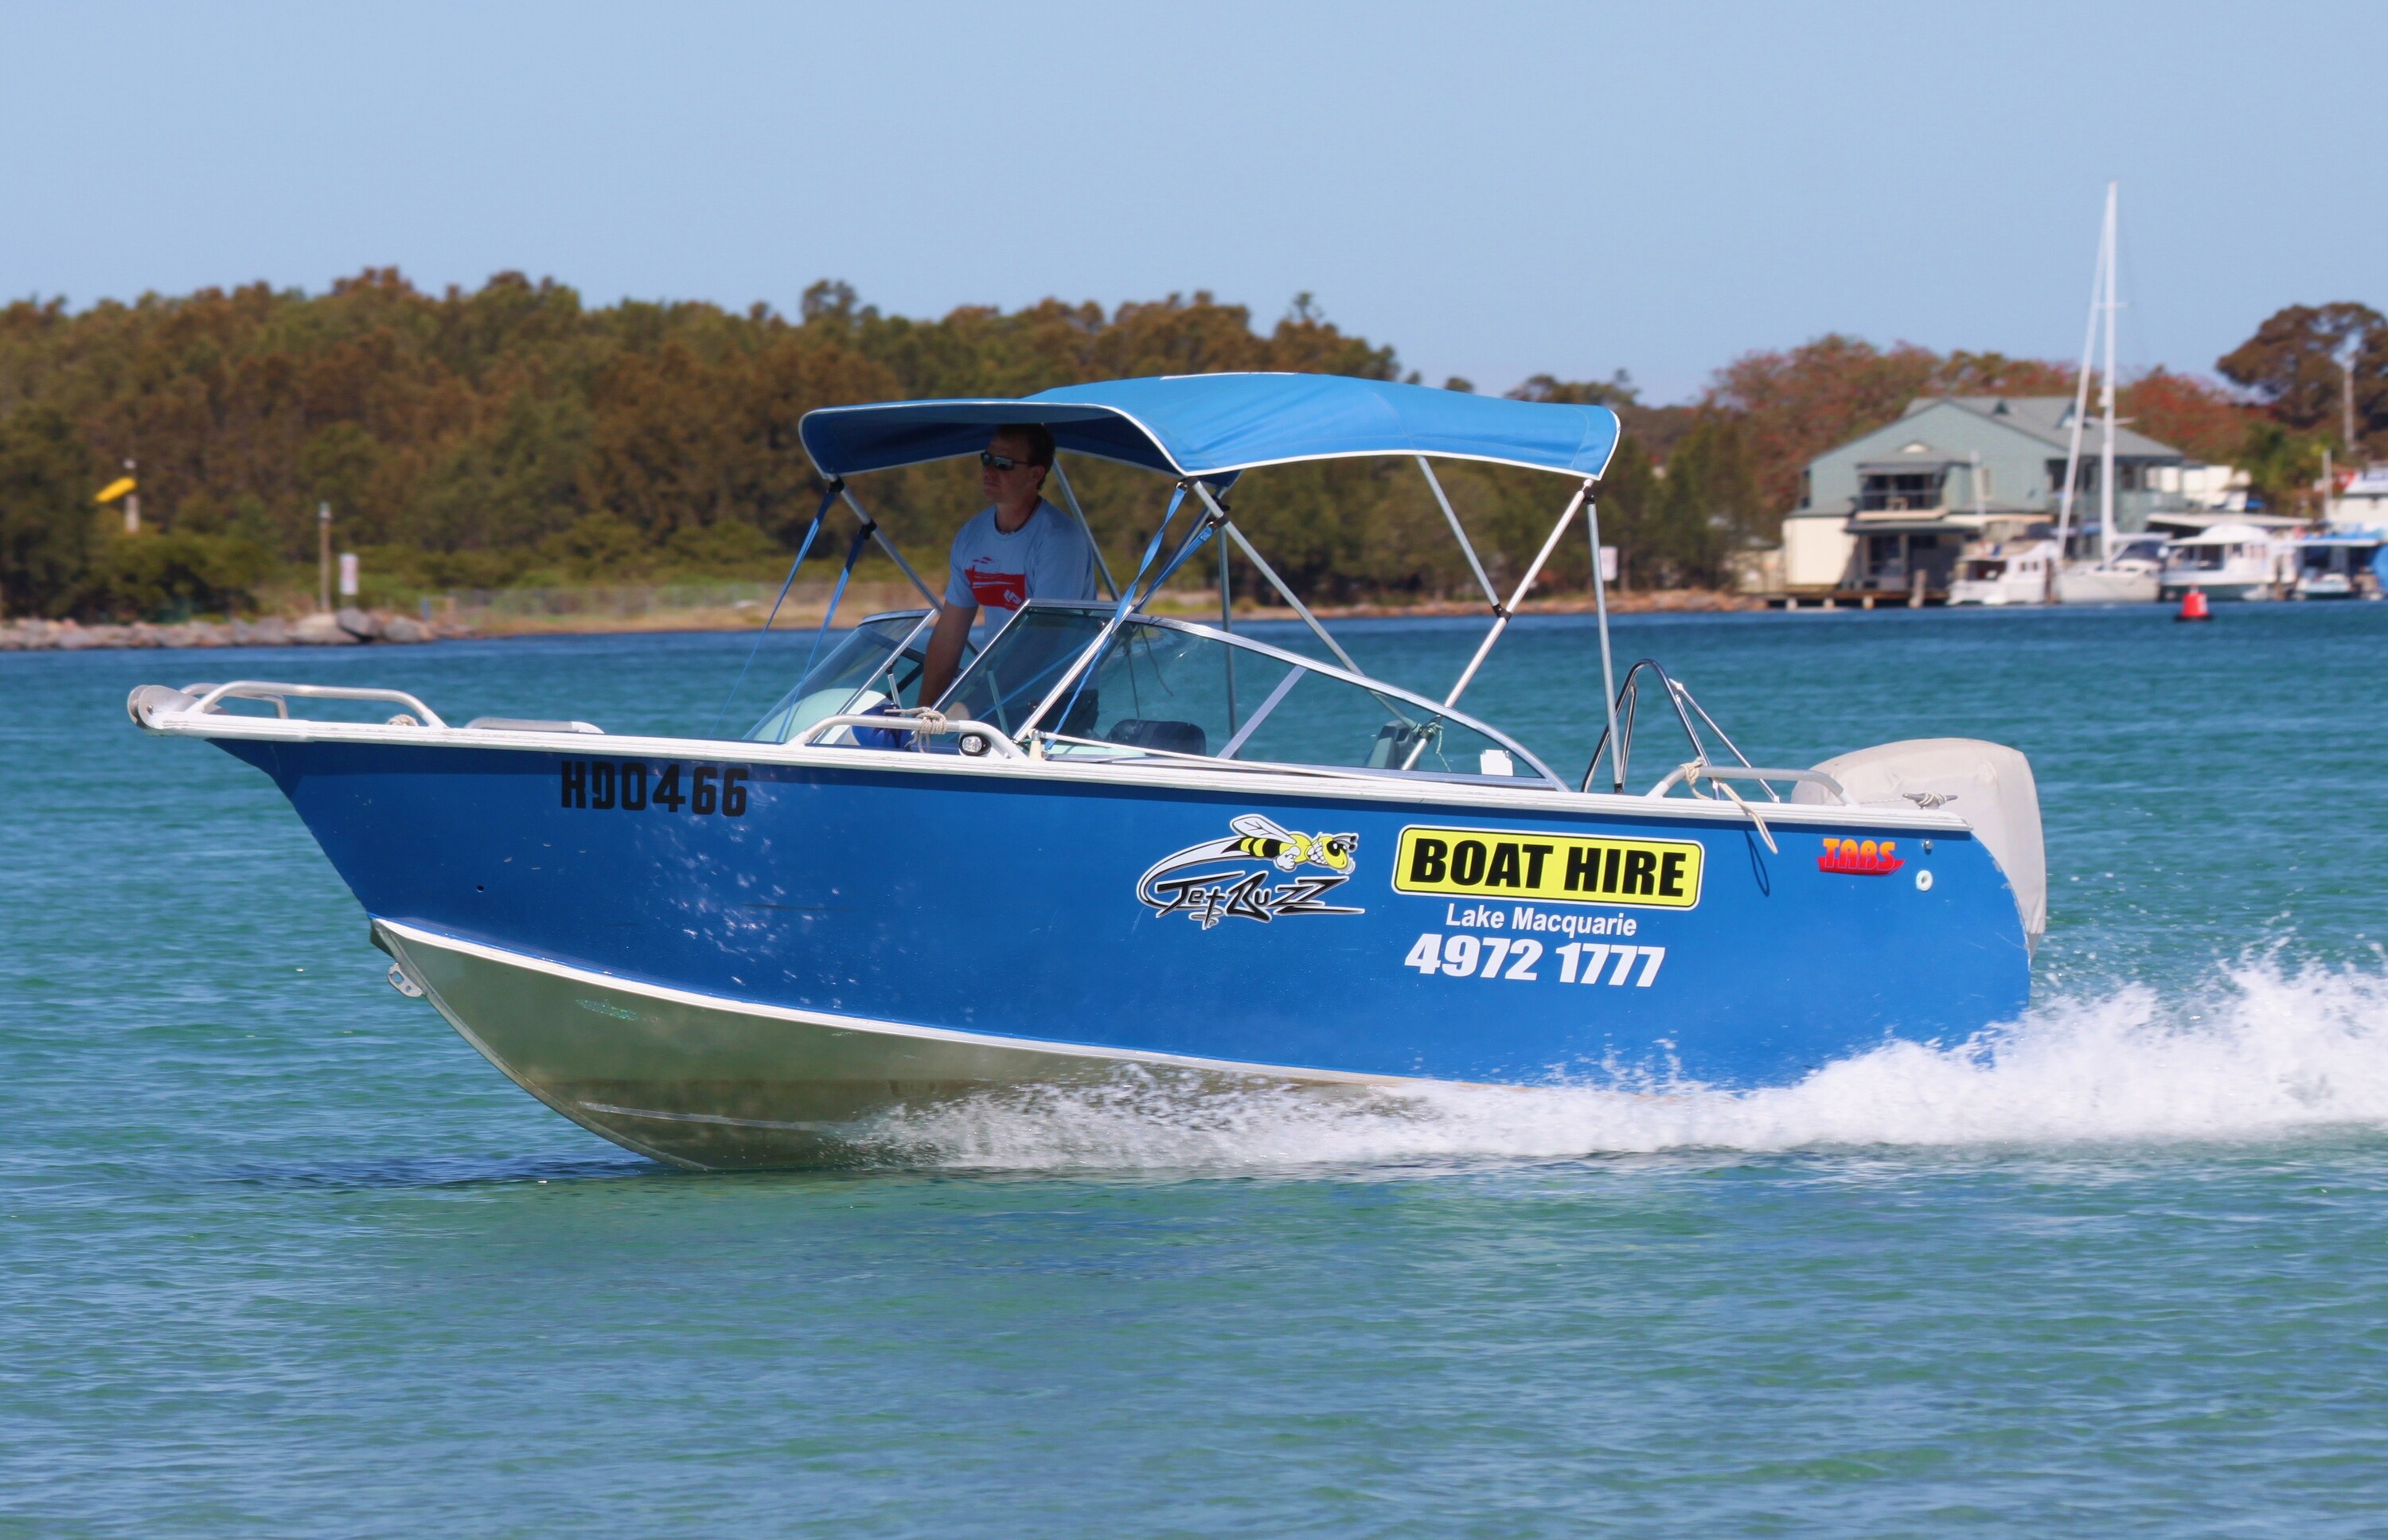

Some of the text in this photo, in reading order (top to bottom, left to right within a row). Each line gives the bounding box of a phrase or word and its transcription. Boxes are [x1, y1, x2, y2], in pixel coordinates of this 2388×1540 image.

[1410, 838, 1687, 897] BOAT HIRE
[1822, 838, 1897, 871] TABS
[1446, 903, 1637, 938] Lake Macquarie
[1404, 933, 1665, 987] 4972 1777
